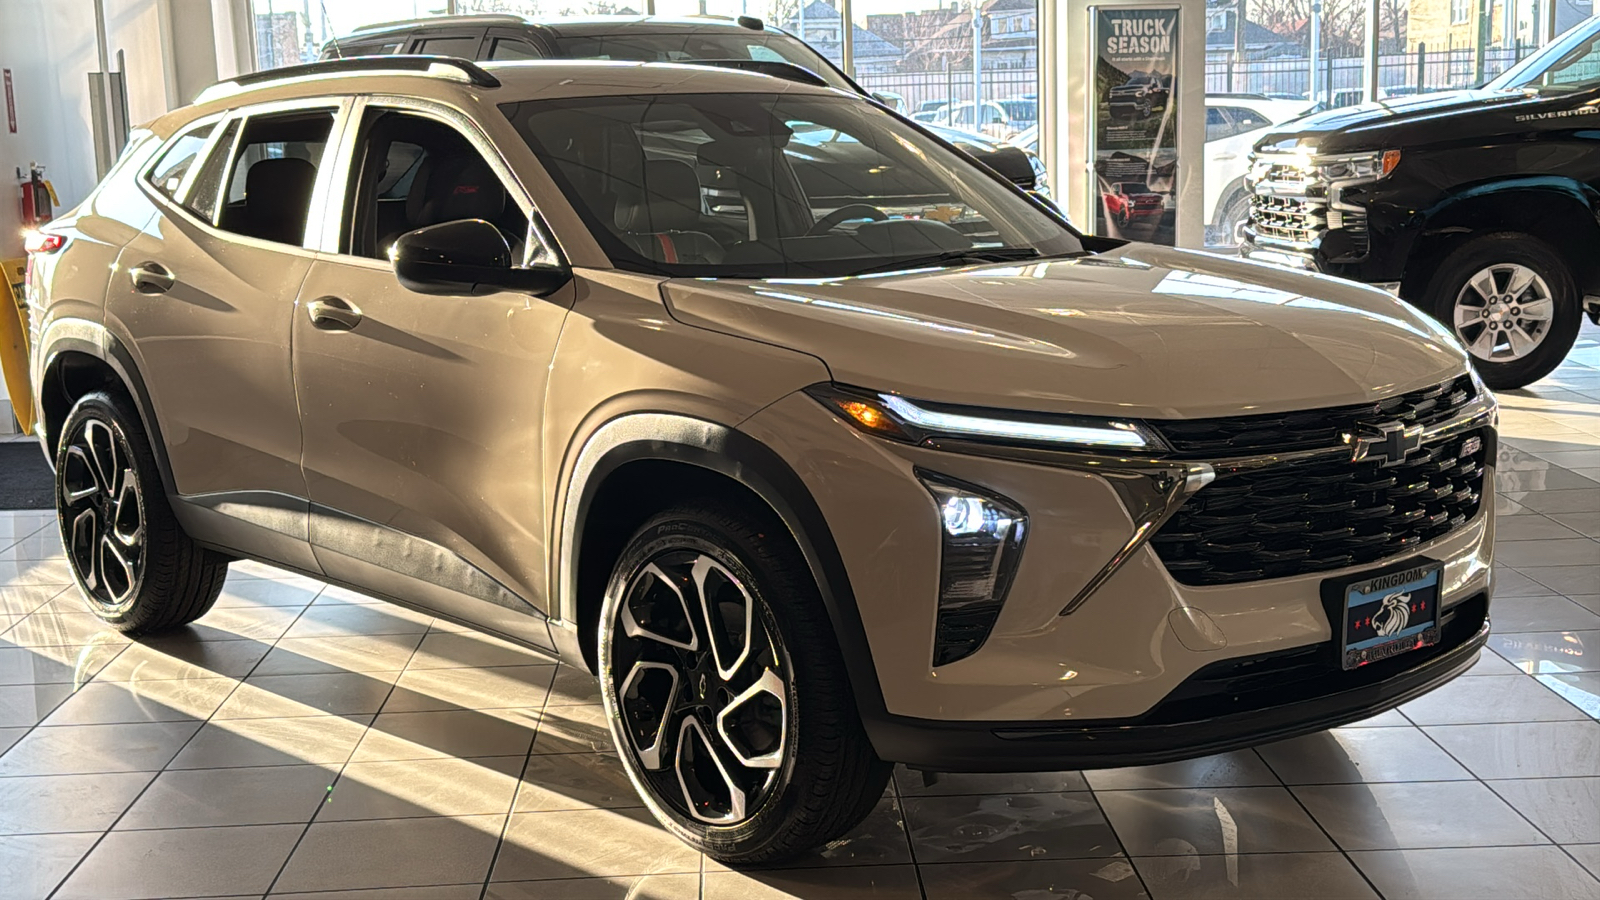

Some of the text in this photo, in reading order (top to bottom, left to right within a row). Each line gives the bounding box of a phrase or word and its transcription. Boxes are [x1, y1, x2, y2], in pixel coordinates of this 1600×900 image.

[1111, 19, 1166, 36] TRUCK
[1107, 36, 1170, 54] SEASON
[1515, 107, 1599, 122] SILVERADO
[1370, 568, 1422, 592] KINGDOM
